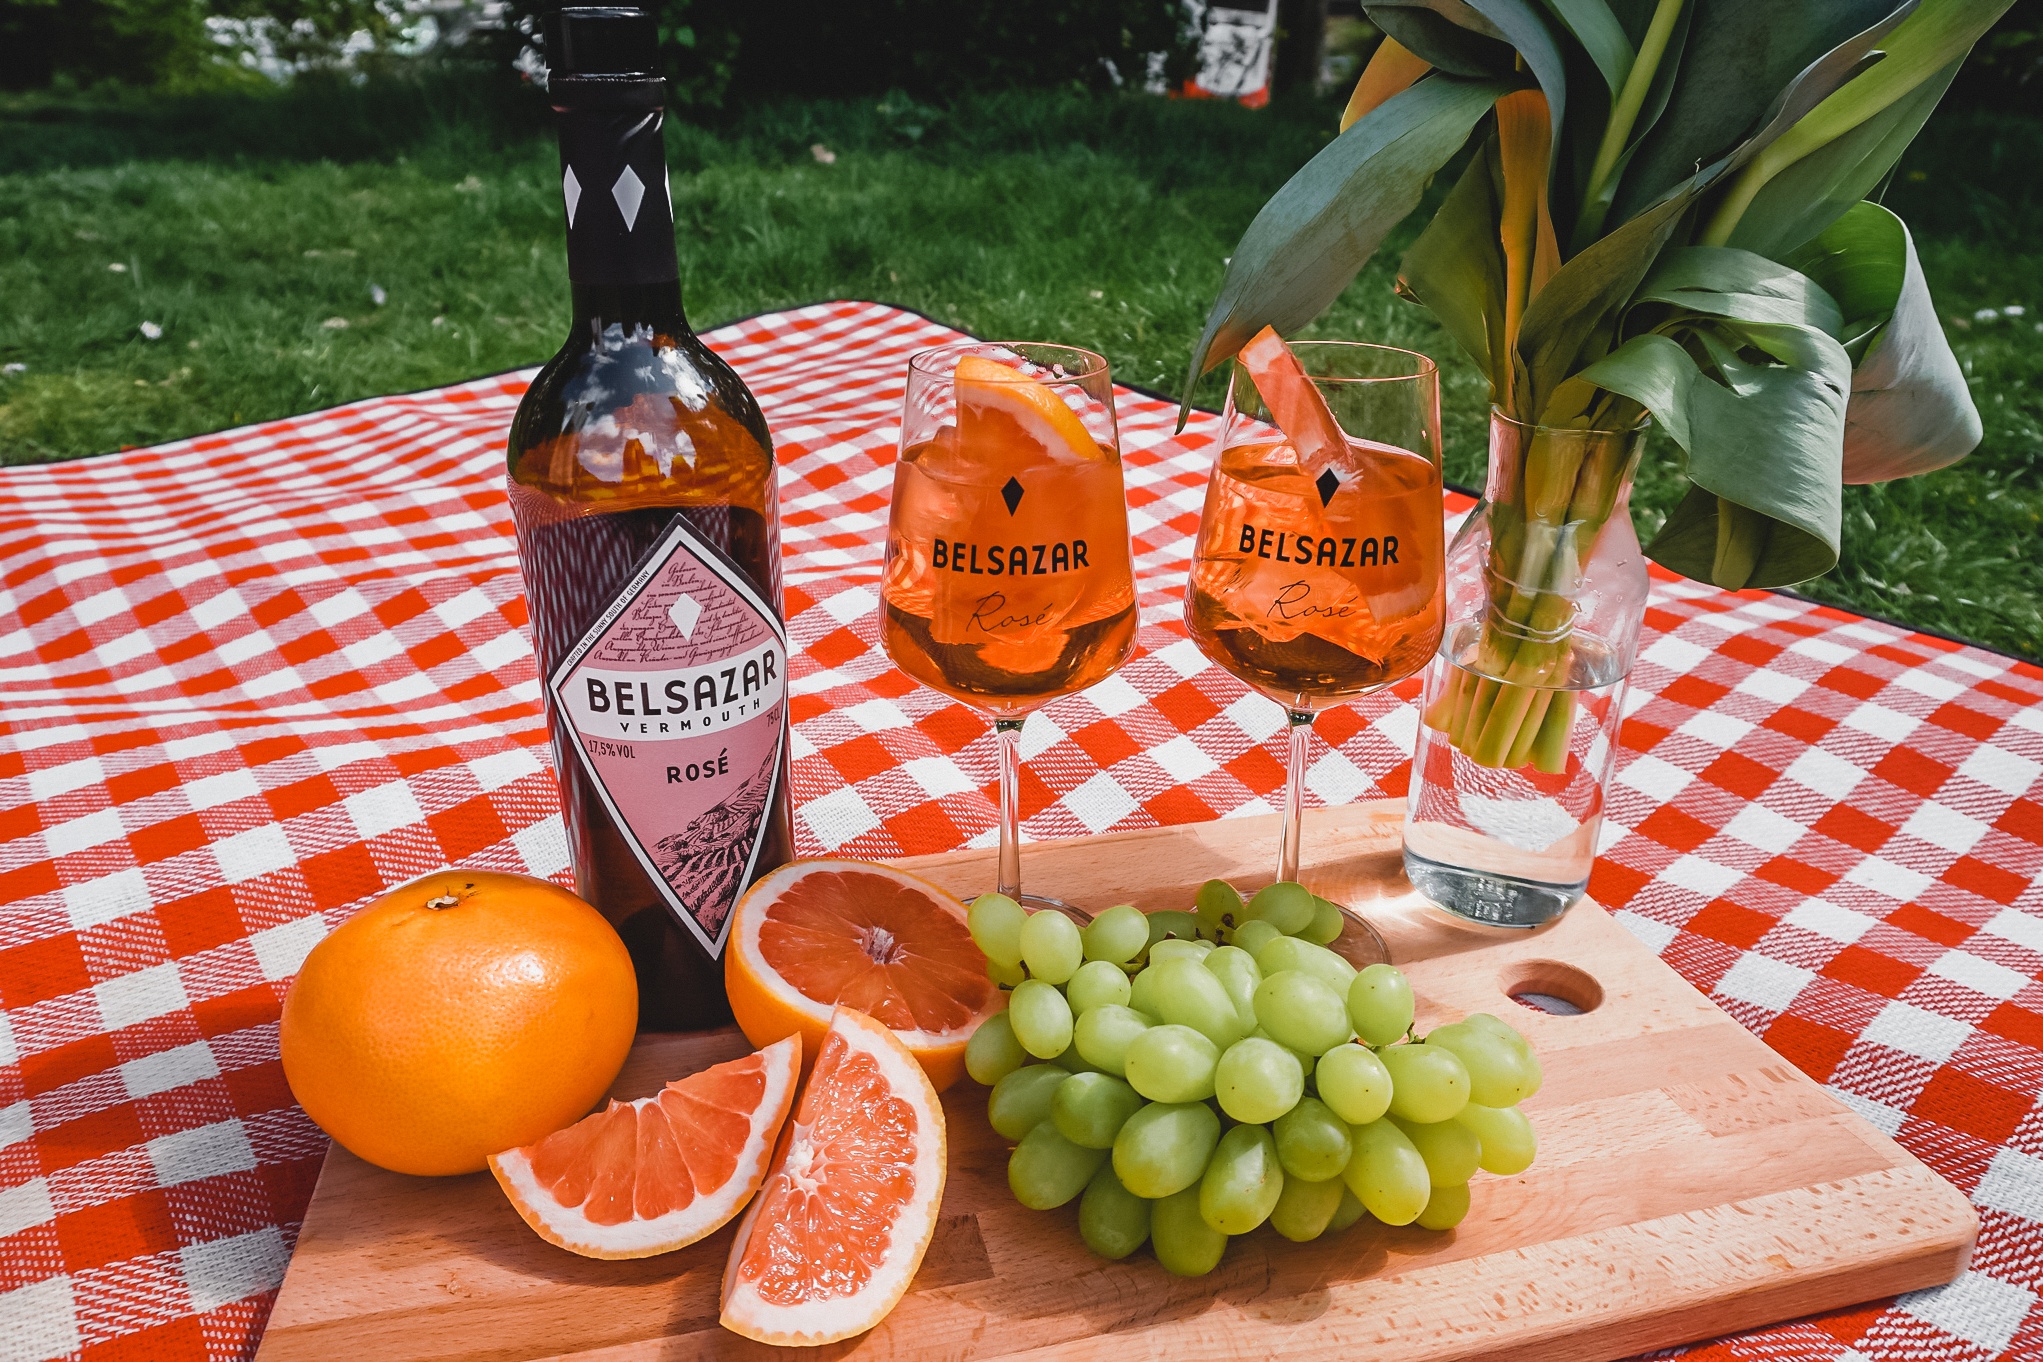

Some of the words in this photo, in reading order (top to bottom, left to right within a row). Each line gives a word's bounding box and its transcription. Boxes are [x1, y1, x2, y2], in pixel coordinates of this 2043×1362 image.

[933, 538, 1090, 576] BELSAZAR
[1239, 523, 1400, 568] BELSAZAR
[566, 649, 583, 667] CRAFTED
[585, 633, 596, 643] THE
[592, 618, 609, 635] SUNNY
[605, 602, 622, 620] SOUTH
[620, 595, 629, 604] OF
[627, 570, 651, 596] GERMANY
[966, 590, 1054, 633] Rosé
[1266, 580, 1359, 620] Rosé
[586, 649, 778, 716] BELSAZAR
[619, 697, 760, 734] VERMOUTH
[666, 747, 729, 784] ROSÉ
